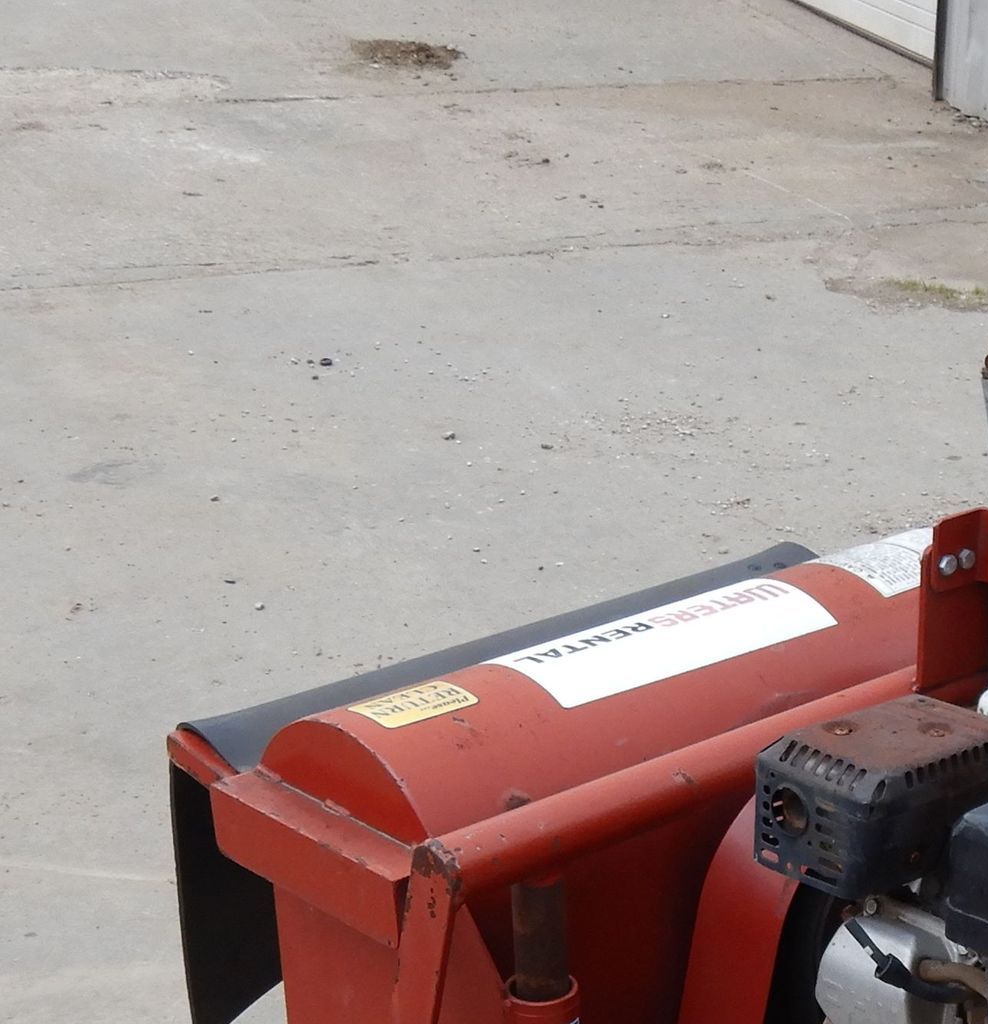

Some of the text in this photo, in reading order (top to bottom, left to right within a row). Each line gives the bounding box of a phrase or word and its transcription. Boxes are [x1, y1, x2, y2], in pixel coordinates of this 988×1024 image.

[513, 583, 790, 664] WATERS RENTAL
[364, 684, 438, 709] CLEAN
[371, 687, 462, 718] RETURN
